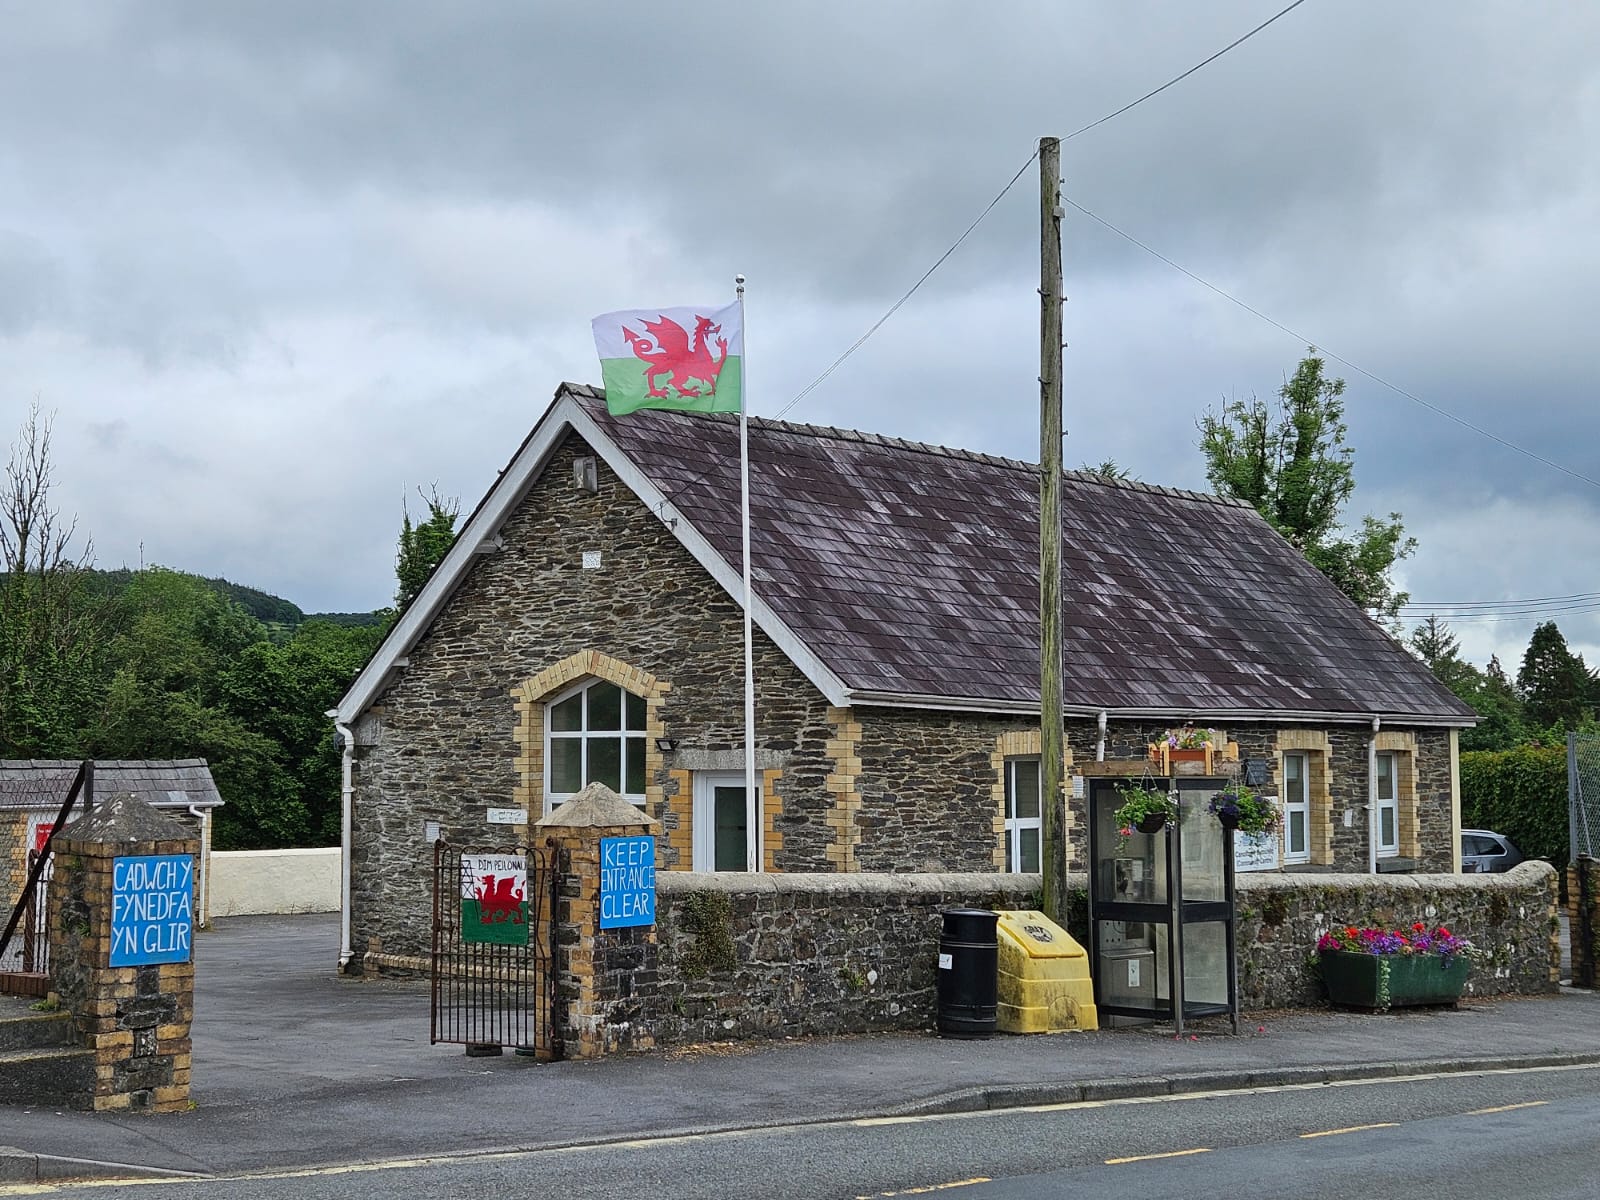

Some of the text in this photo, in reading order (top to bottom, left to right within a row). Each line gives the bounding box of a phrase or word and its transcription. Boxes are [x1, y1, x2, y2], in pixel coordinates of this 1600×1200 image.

[478, 859, 493, 871] DIM
[605, 842, 649, 867] KEEP
[113, 861, 192, 891] CADWCH Y
[601, 866, 655, 892] ENTRANCE
[113, 891, 191, 922] FYNEDFA
[602, 893, 650, 919] CLEAR
[112, 922, 189, 955] YN GLIR
